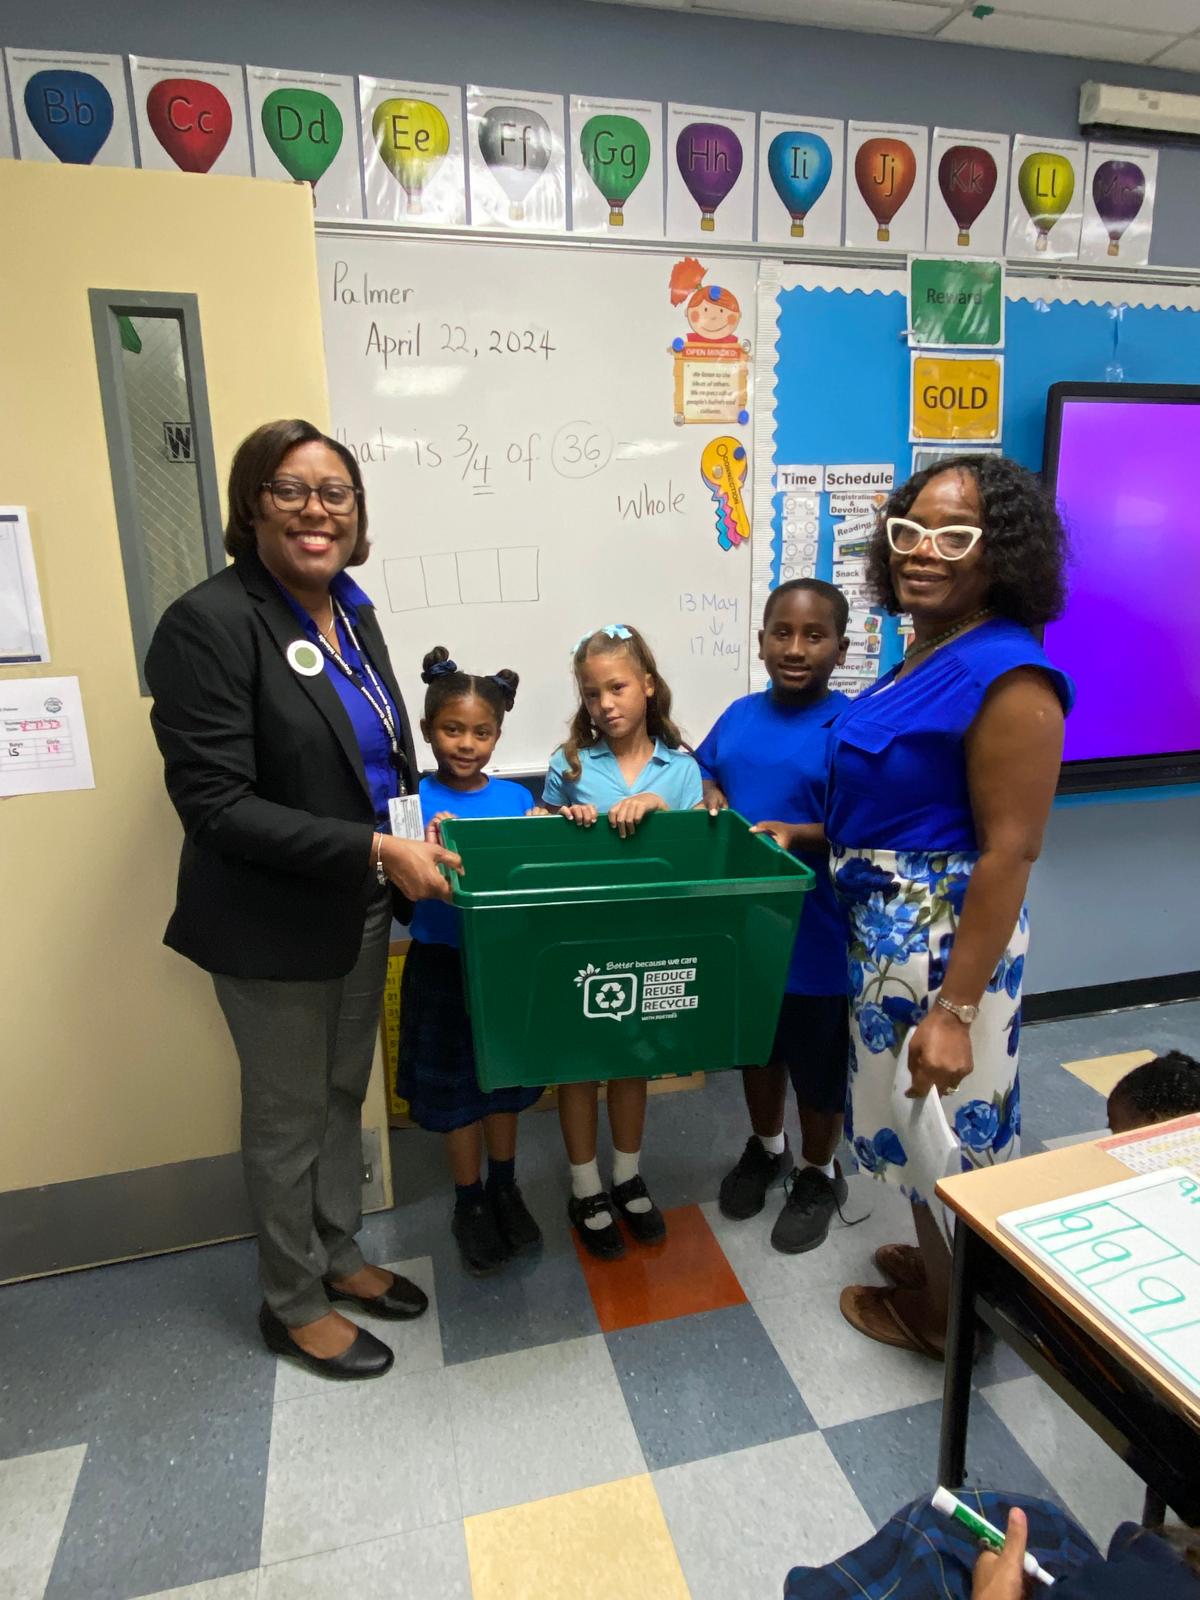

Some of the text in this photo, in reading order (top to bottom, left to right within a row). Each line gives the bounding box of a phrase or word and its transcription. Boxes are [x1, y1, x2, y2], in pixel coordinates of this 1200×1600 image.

[43, 87, 95, 127] Bb
[167, 95, 215, 134] Cc
[277, 104, 330, 145] Dd
[391, 114, 430, 152] Ee
[499, 123, 532, 170] Ff
[593, 130, 636, 179] Gg
[689, 137, 732, 174] Hh
[790, 146, 809, 180] Ii
[873, 153, 896, 198] Jj
[950, 157, 986, 194] Kk
[1035, 167, 1057, 198] Ll
[333, 260, 415, 305] Palmer
[926, 287, 984, 305] Reward
[365, 321, 557, 370] April 22, 2024
[922, 386, 988, 411] GOLD
[166, 426, 191, 459] W
[413, 427, 442, 468] is
[507, 432, 542, 481] of
[562, 434, 601, 464] 36
[781, 472, 817, 485] Time
[826, 472, 893, 486] Schedule
[617, 479, 687, 520] Whole
[830, 506, 869, 514] Devotion
[837, 521, 872, 537] Reading
[835, 570, 859, 578] Snack
[679, 592, 739, 623] 13 May
[690, 635, 741, 671] 17 May
[606, 961, 635, 971] Better
[635, 959, 667, 968] because
[645, 970, 694, 983] REDUCE
[643, 997, 697, 1011] RECYCLE
[644, 984, 683, 997] REUSE
